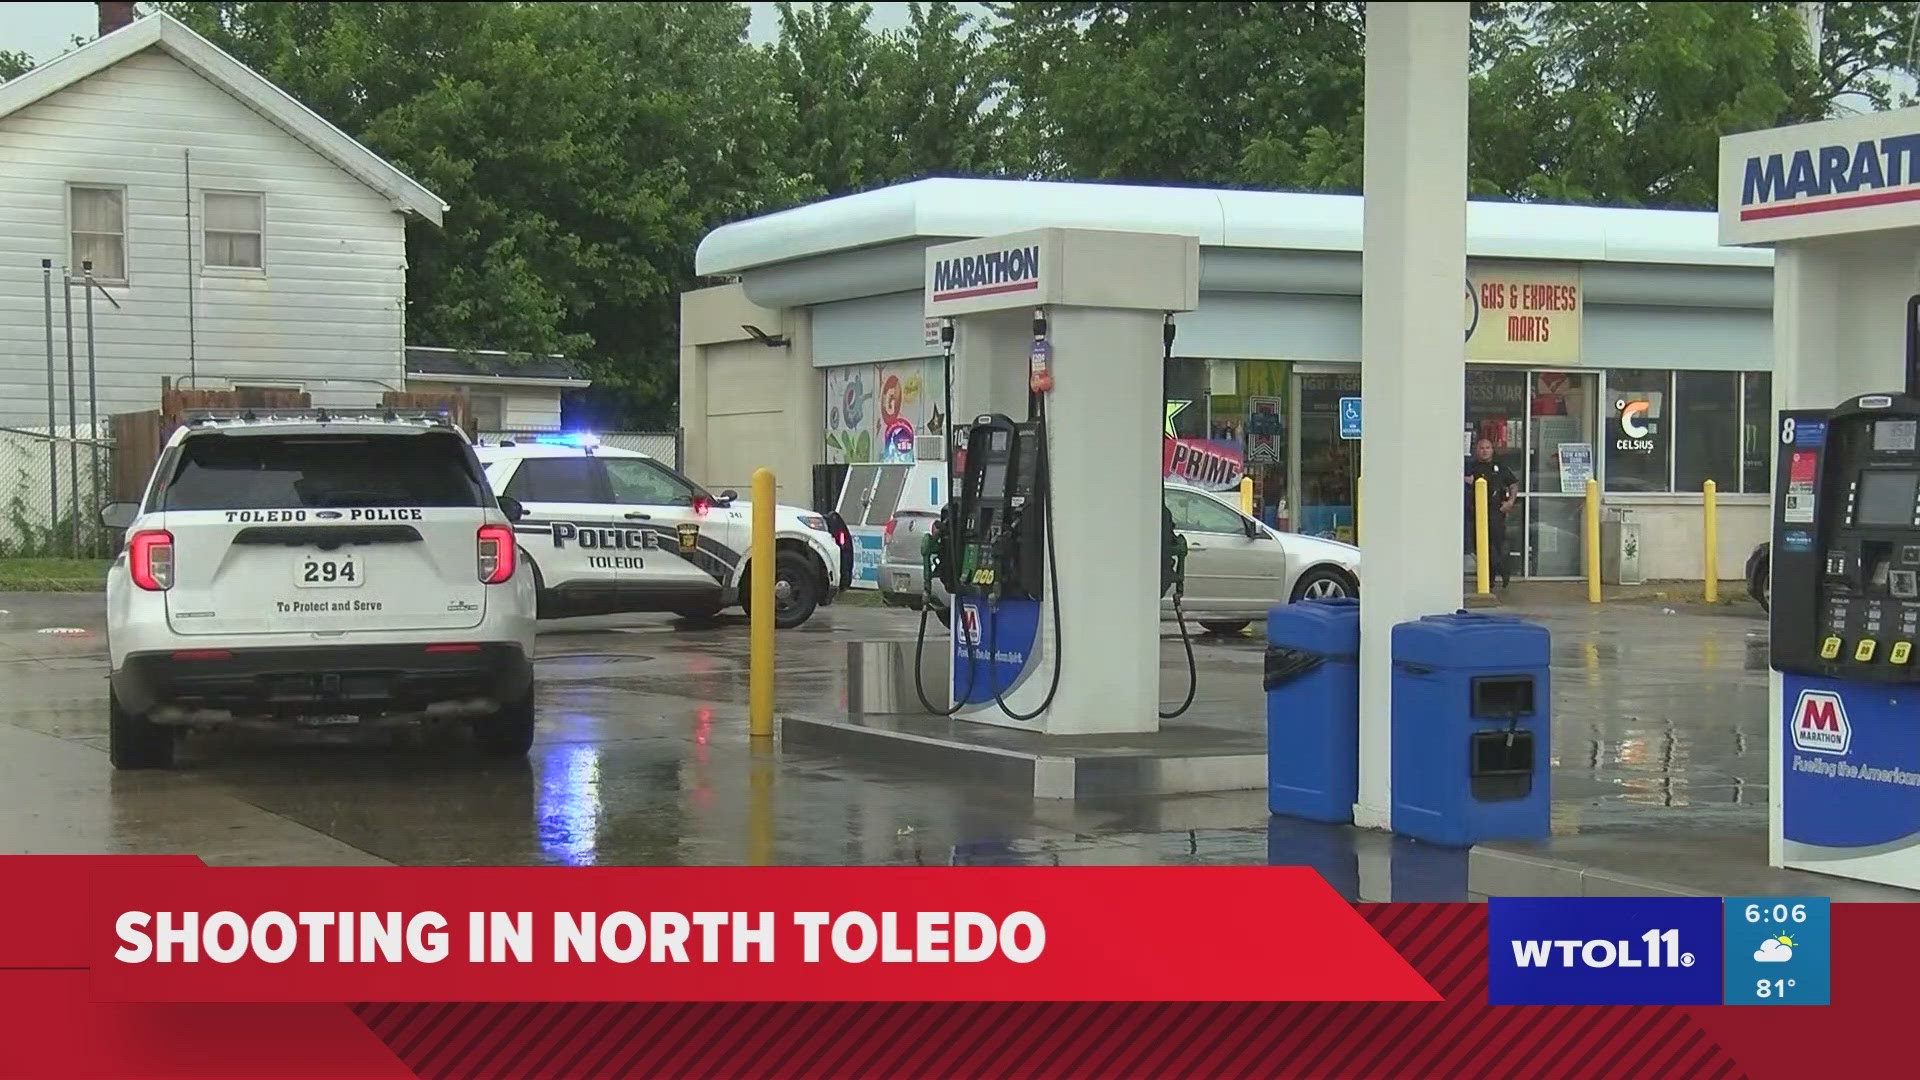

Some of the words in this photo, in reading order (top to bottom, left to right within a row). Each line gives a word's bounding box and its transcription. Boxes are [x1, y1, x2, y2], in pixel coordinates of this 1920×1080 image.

[934, 245, 1039, 292] MARATHON
[1481, 282, 1504, 309] GAS
[1510, 283, 1518, 309] &
[1522, 284, 1576, 311] EXPRESS
[1507, 315, 1549, 342] MARTS
[1781, 418, 1796, 444] 8
[1616, 439, 1654, 451] CELSIUS
[1169, 443, 1242, 484] PRIME
[225, 510, 307, 523] TOLEDO
[351, 508, 423, 521] POLICE
[551, 522, 659, 551] POLICE
[304, 561, 355, 583] 294
[588, 556, 644, 570] TOLEDO
[277, 601, 290, 612] To
[293, 601, 330, 612] Protect
[332, 601, 351, 611] and
[354, 601, 382, 611] Serve
[1895, 649, 1906, 658] 93
[1801, 699, 1839, 732] M
[1799, 730, 1842, 745] MARATHON
[1792, 755, 1837, 778] Fueling
[1837, 761, 1858, 777] the
[1858, 763, 1920, 786] American
